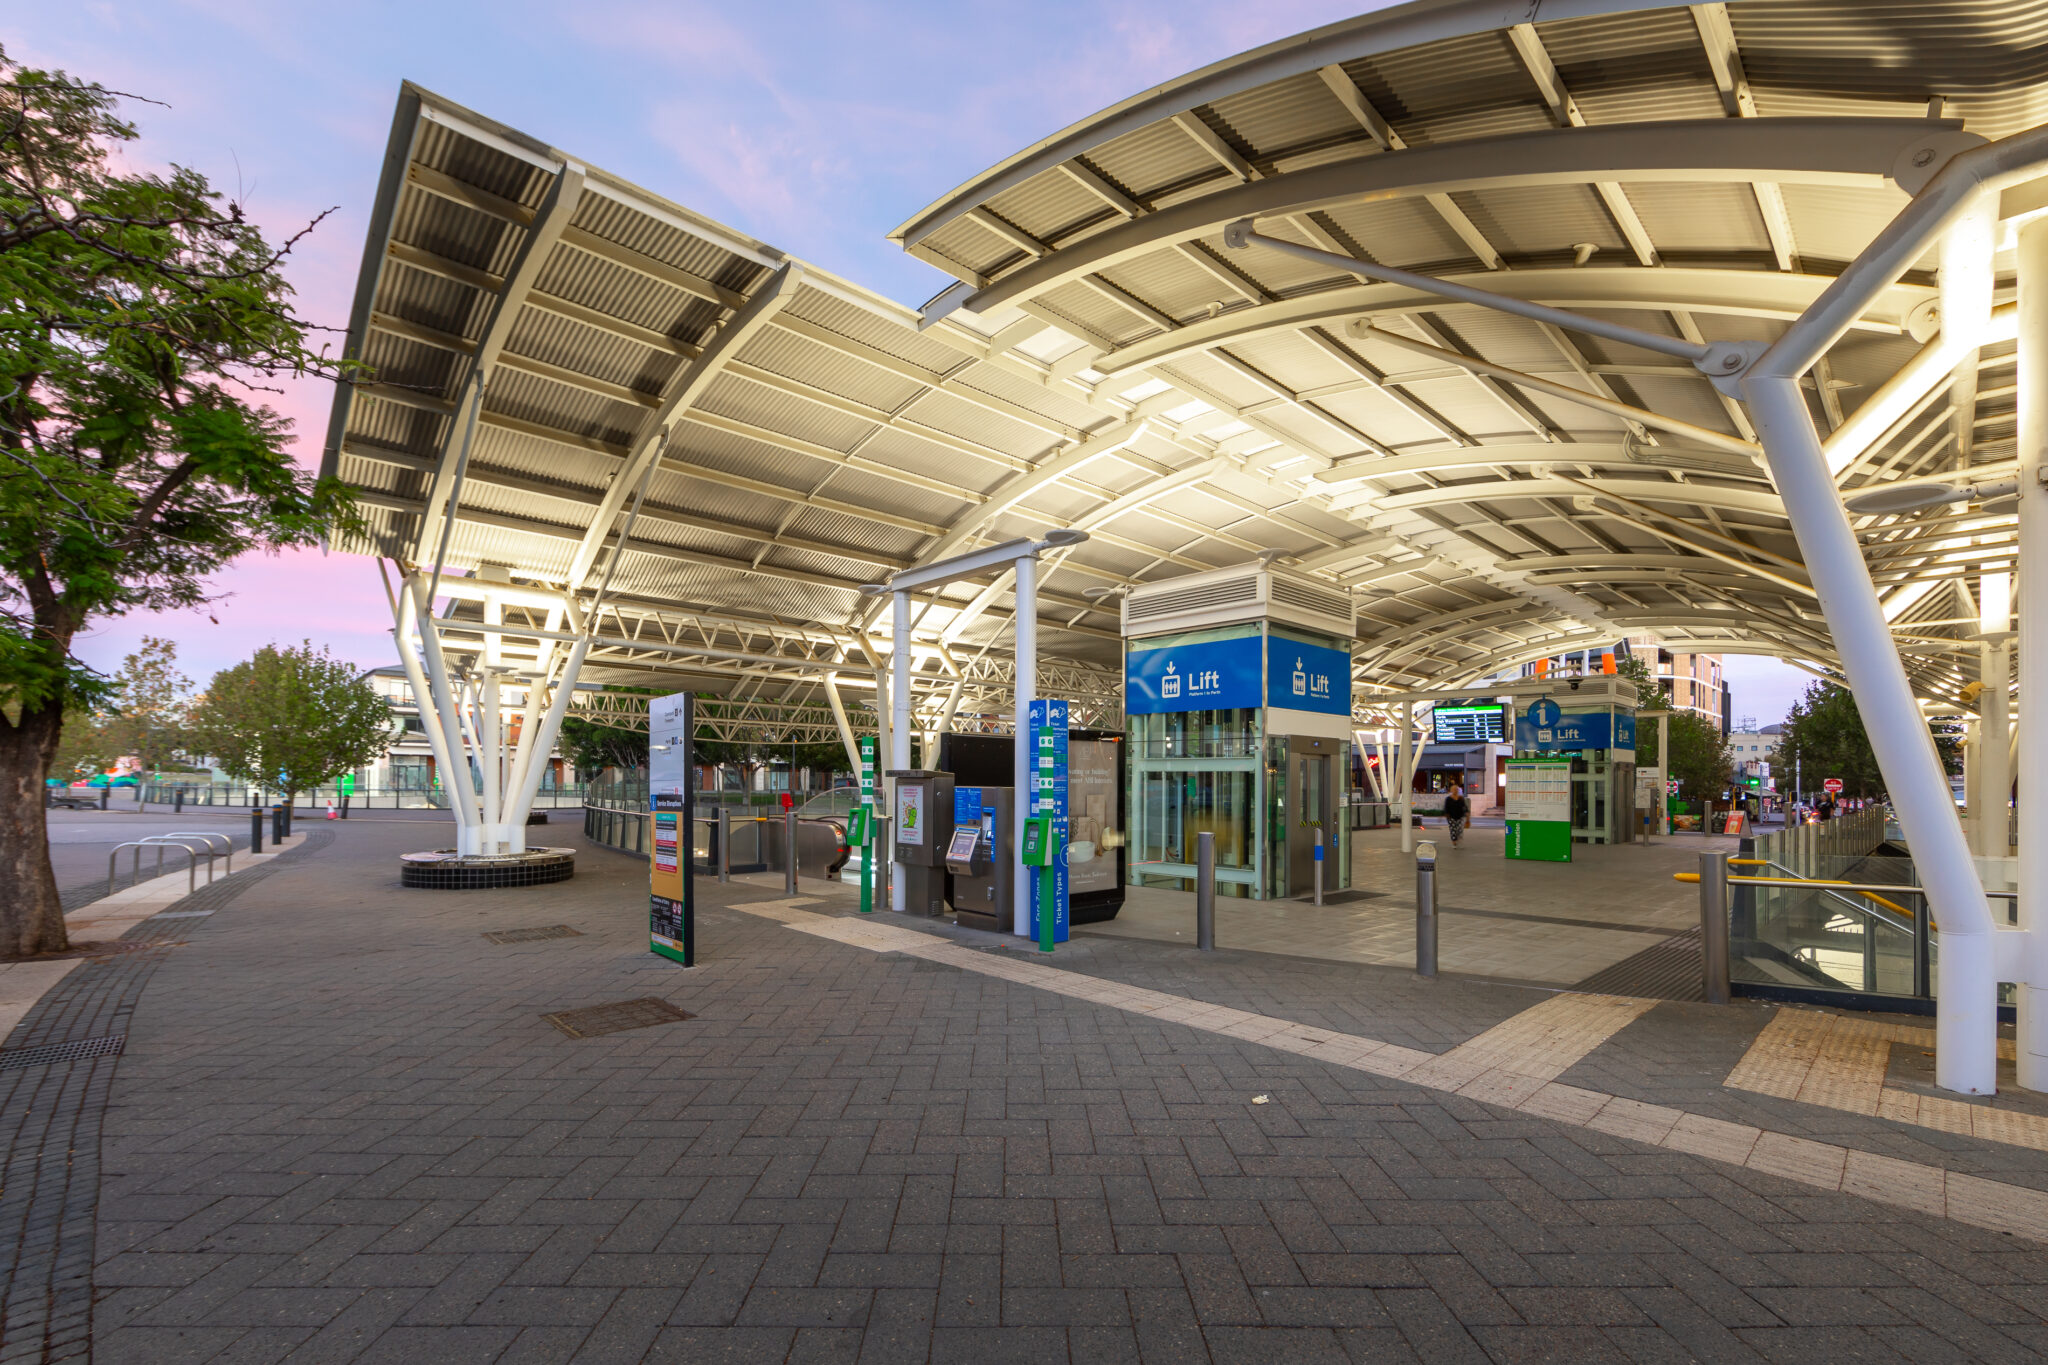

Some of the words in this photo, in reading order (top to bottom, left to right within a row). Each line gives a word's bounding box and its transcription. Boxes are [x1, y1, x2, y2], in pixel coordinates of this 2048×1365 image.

[1188, 670, 1220, 690] Lift
[1310, 673, 1329, 693] Lift
[1557, 729, 1579, 739] Lift
